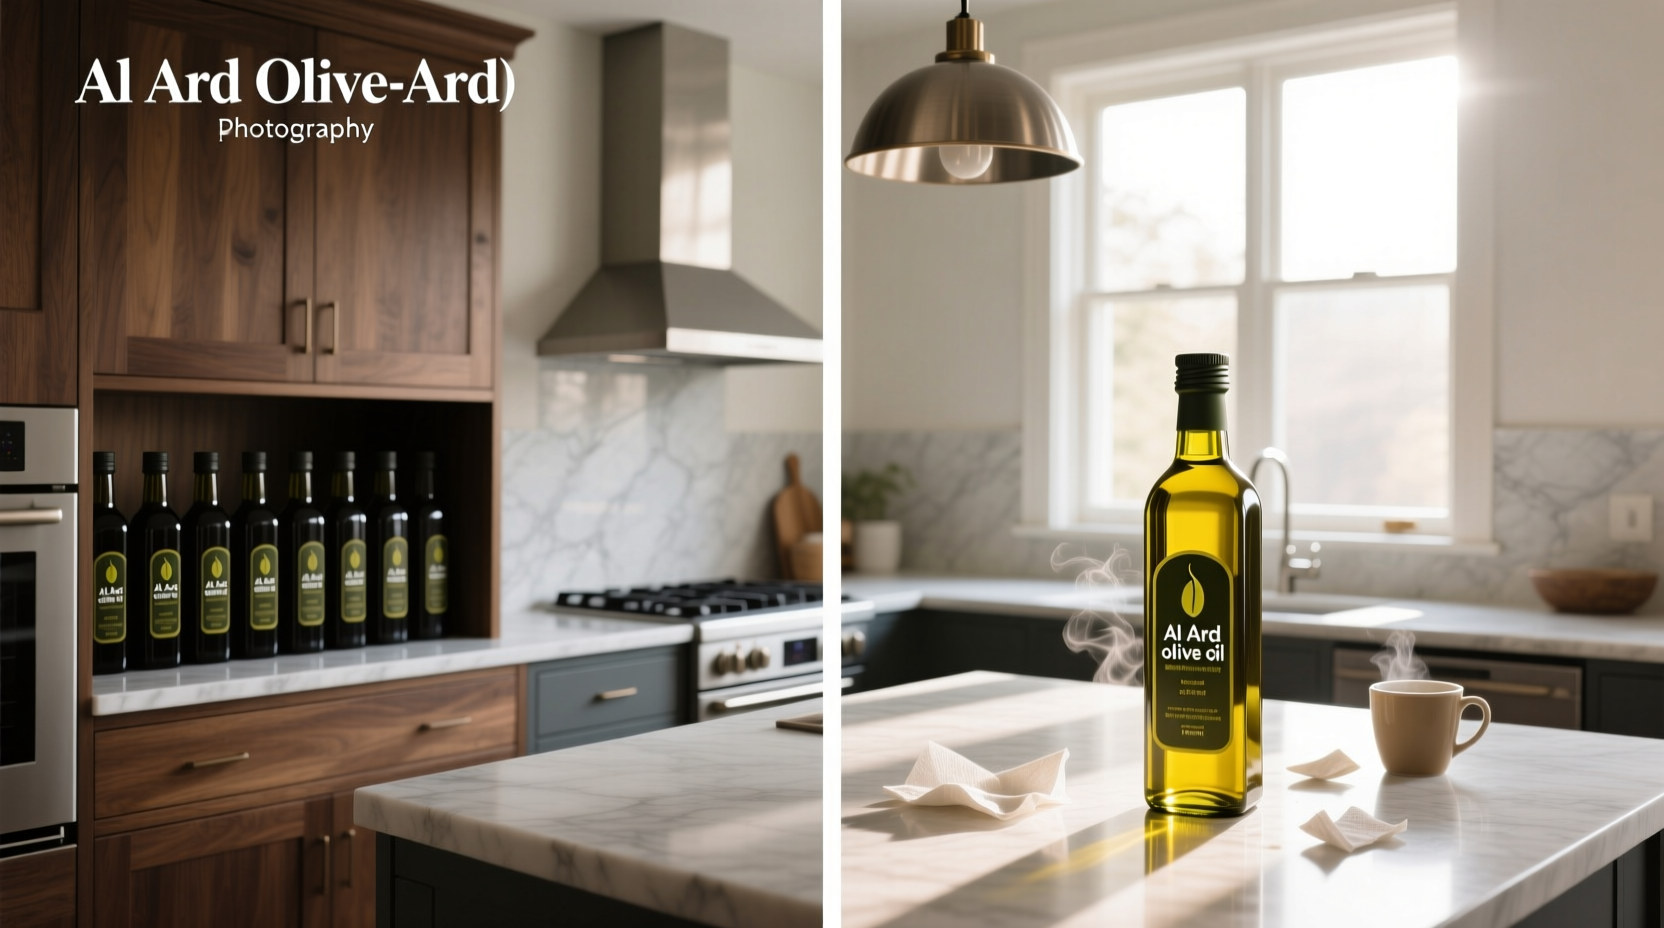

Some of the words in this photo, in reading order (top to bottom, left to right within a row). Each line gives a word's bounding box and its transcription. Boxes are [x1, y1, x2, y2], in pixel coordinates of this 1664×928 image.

[1163, 623, 1182, 642] Al
[1186, 623, 1221, 643] Ard
[1161, 643, 1202, 661] olive
[1205, 643, 1225, 662] oil
